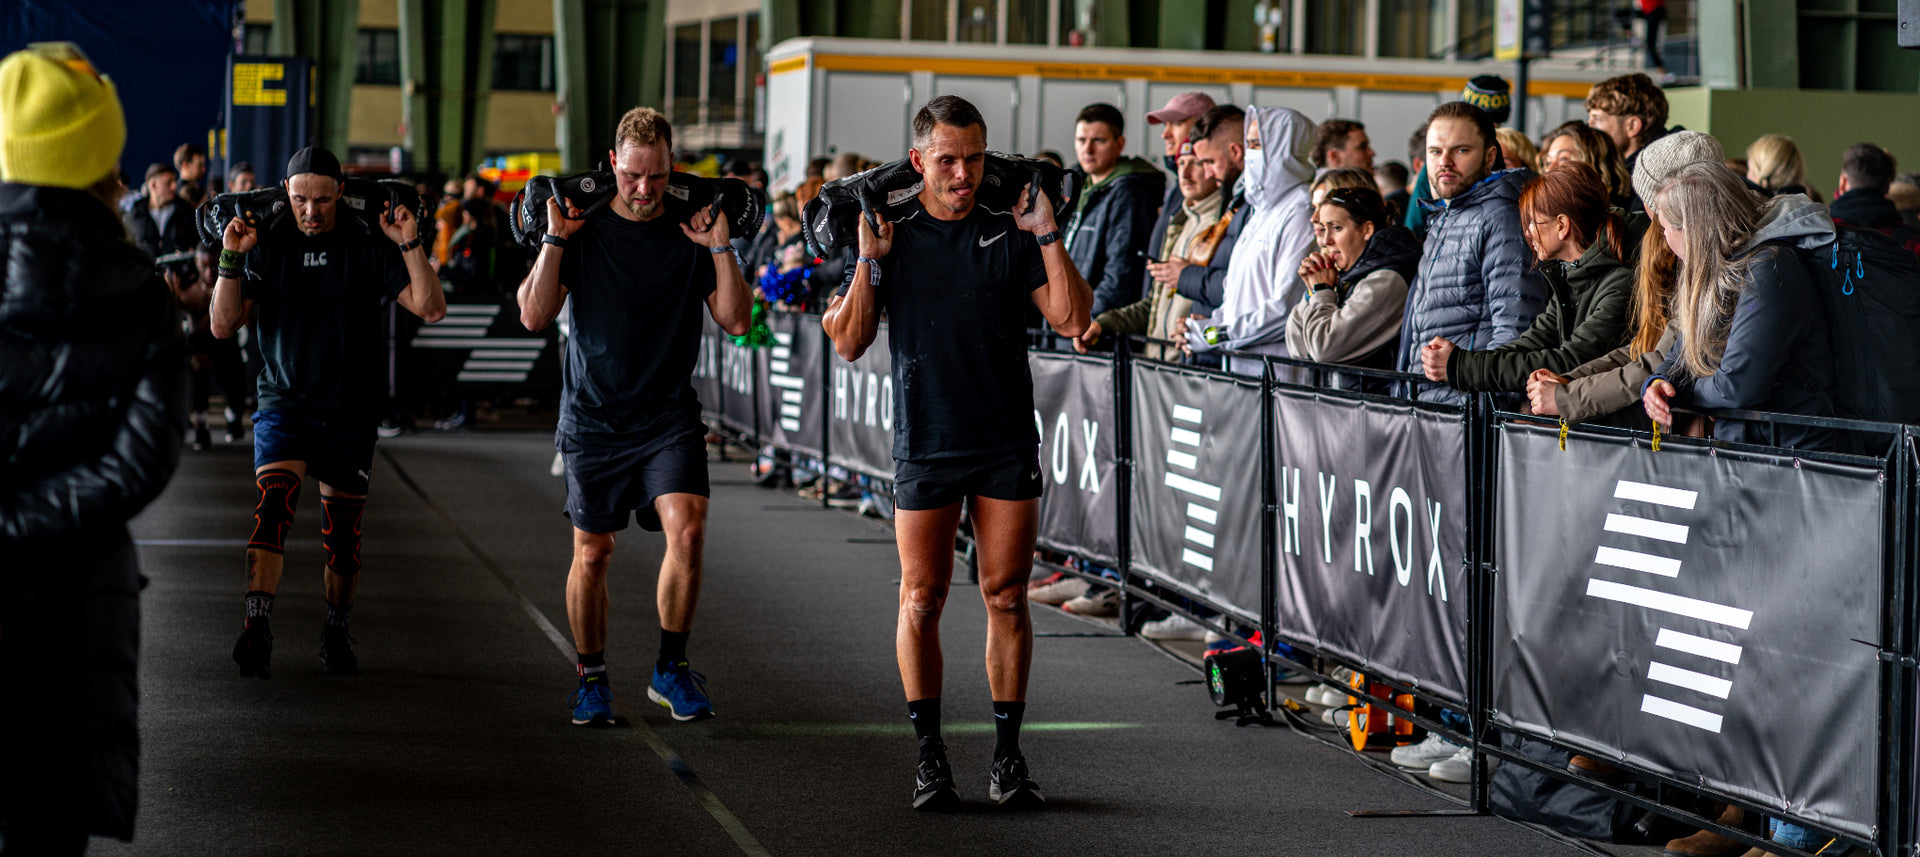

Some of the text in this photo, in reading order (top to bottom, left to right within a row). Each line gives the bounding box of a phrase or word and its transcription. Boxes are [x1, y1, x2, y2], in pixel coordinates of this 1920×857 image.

[890, 183, 921, 200] HYRO
[834, 366, 893, 431] HYRO
[1035, 408, 1100, 493] OX
[1282, 466, 1448, 602] HYROX
